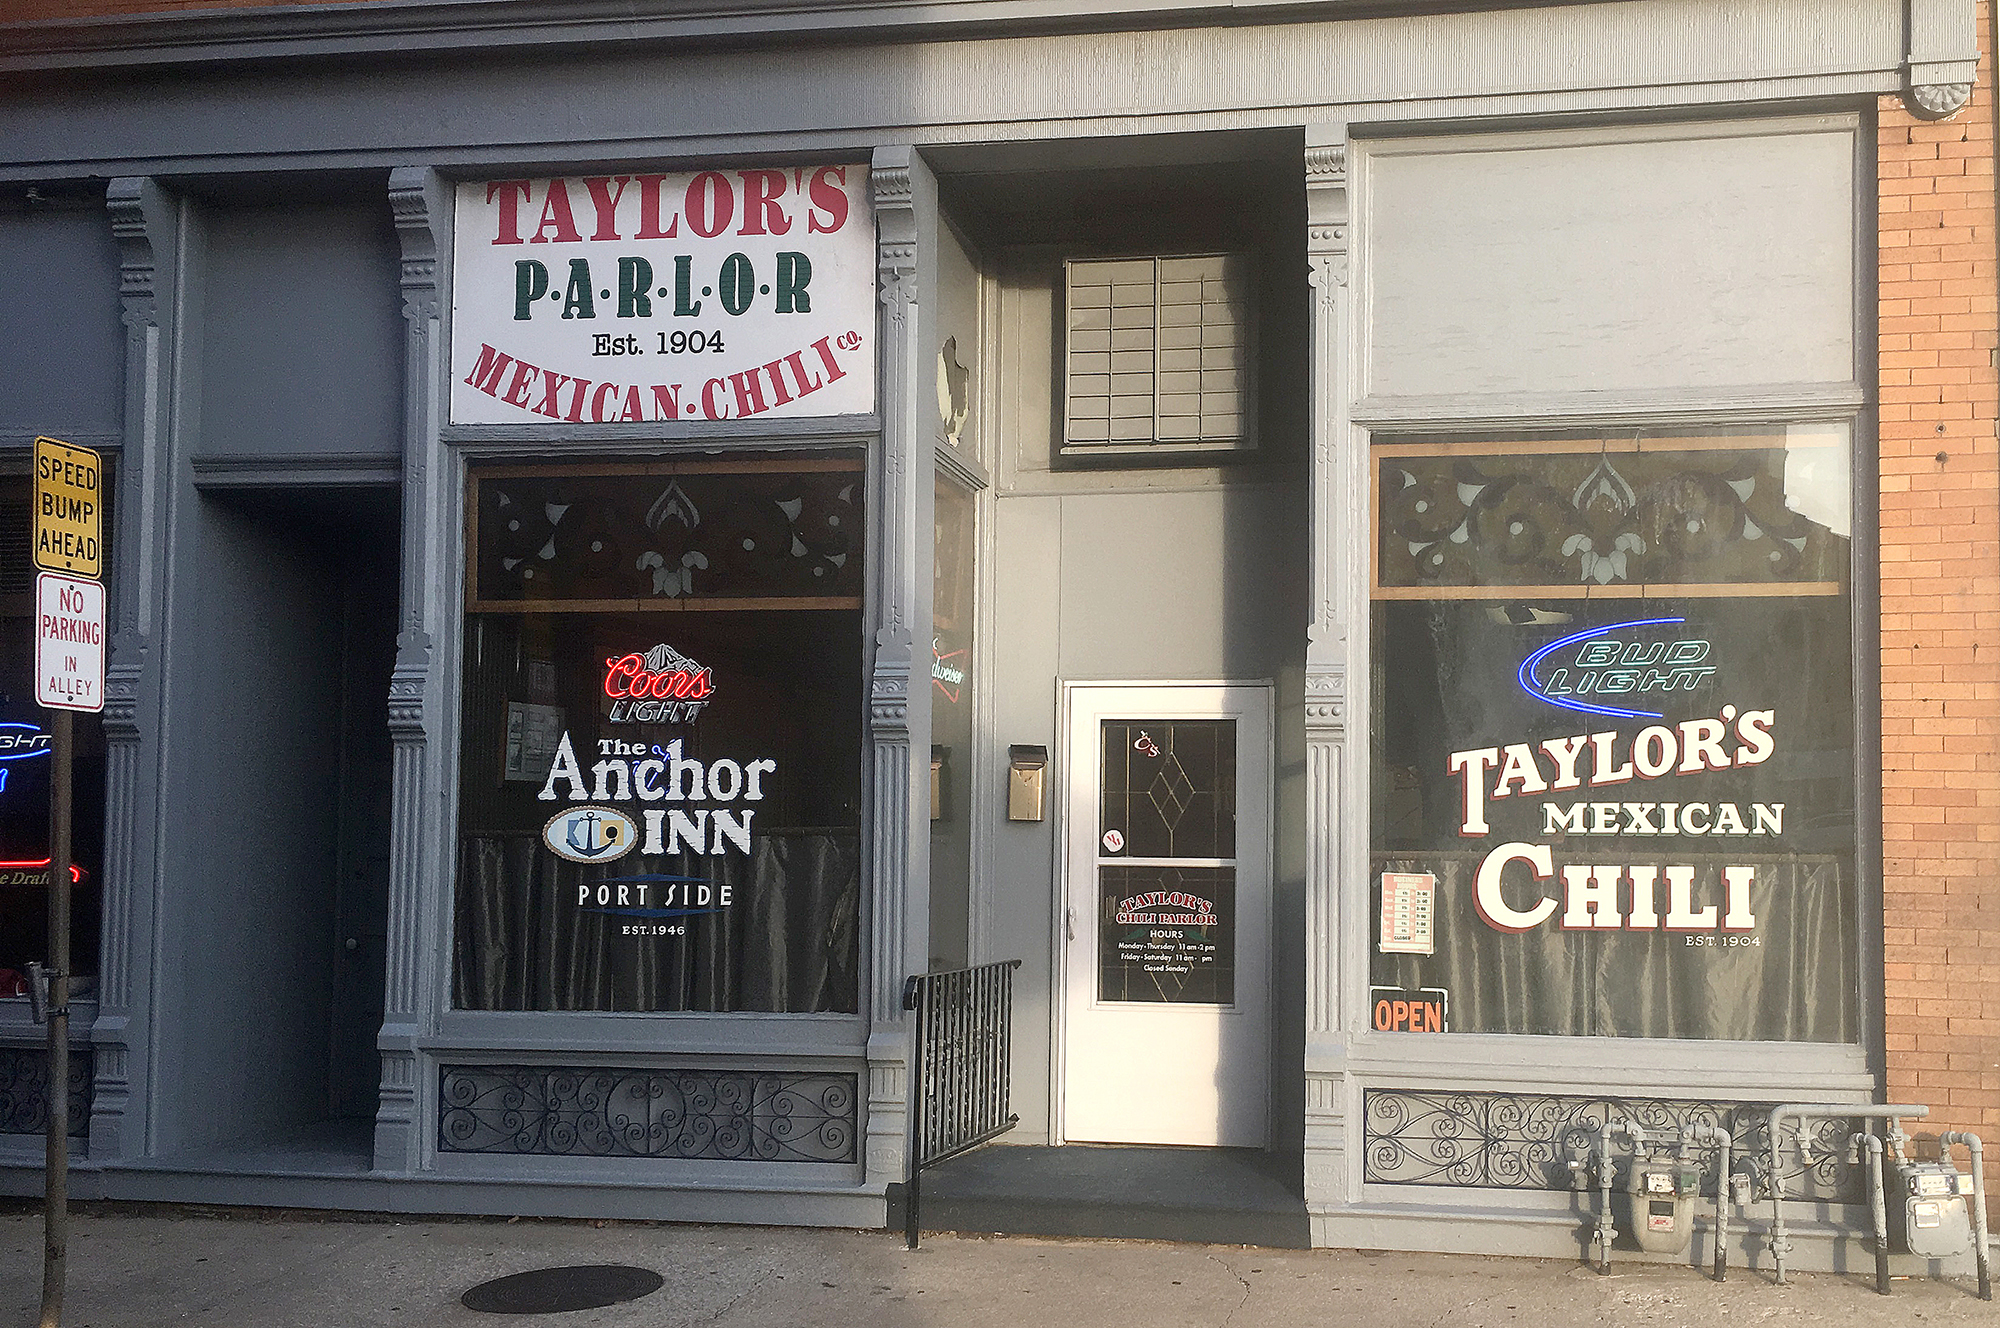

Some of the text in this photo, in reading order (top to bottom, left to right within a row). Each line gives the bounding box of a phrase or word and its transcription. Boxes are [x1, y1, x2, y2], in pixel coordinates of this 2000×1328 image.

[486, 166, 850, 246] TAYLOR'S
[592, 330, 725, 357] Est. 1904
[39, 455, 97, 491] SPEED
[42, 492, 94, 525] BUMP
[39, 528, 97, 562] AHEAD
[60, 588, 84, 614] NO
[43, 614, 100, 645] PARKING
[64, 655, 78, 673] IN
[1575, 640, 1711, 667] BUD
[49, 677, 92, 696] ALLEY
[604, 652, 717, 699] Coors
[1543, 666, 1717, 694] LIGHT
[609, 701, 710, 723] LIGHT
[598, 739, 647, 755] The
[538, 730, 777, 801] Anchor
[1447, 704, 1775, 837] TAYLOR'S
[641, 809, 755, 856] INN
[1542, 802, 1785, 837] MEXICAN
[578, 884, 733, 907] PORT SIDE
[1472, 842, 1757, 934] CHILI
[1120, 892, 1213, 914] TAYLOR'S
[1116, 913, 1218, 926] CHILI PARLOR
[1150, 930, 1184, 938] HOURS
[1685, 935, 1761, 946] EST. 1904
[1375, 999, 1441, 1033] OPEN
